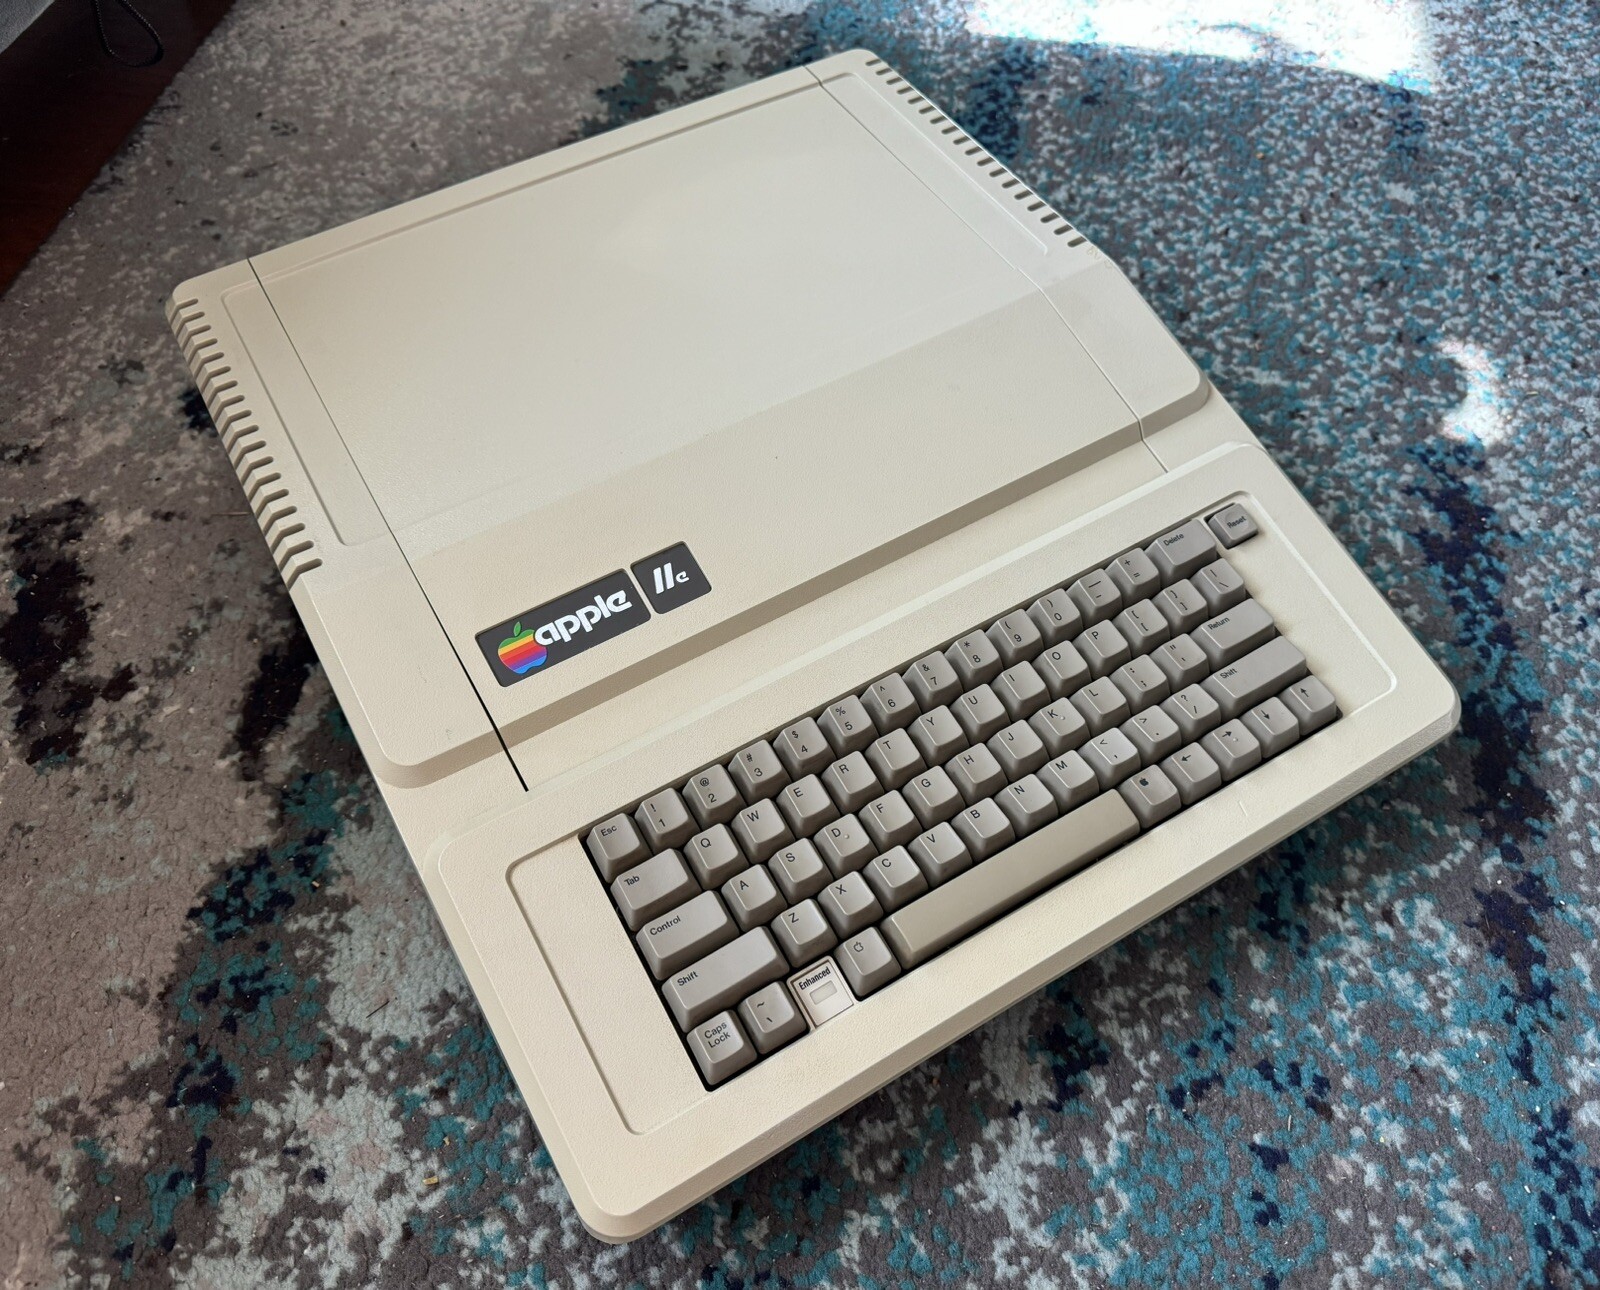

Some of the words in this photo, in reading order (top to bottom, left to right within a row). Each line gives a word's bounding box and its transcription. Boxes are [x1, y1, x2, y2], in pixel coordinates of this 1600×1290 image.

[1227, 516, 1246, 529] Reset
[1163, 533, 1184, 546] Delete
[535, 590, 632, 642] apple
[1208, 617, 1230, 630] Return
[1014, 634, 1022, 642] 9
[1092, 631, 1099, 639] P
[973, 655, 981, 663] 8
[1052, 652, 1061, 660] O
[1220, 668, 1238, 679] Shift
[930, 677, 938, 685] 7
[1088, 689, 1098, 697] L
[888, 699, 895, 708] 6
[968, 696, 978, 705] U
[1048, 709, 1058, 718] K
[845, 722, 852, 730] 5
[926, 717, 935, 726] Y
[1008, 732, 1014, 741] J
[801, 745, 808, 753] 4
[883, 741, 892, 750] T
[964, 755, 974, 764] H
[839, 764, 849, 774] R
[1056, 760, 1068, 770] M
[754, 768, 762, 777] 3
[921, 778, 931, 788] G
[793, 788, 803, 798] E
[1014, 785, 1025, 794] N
[708, 793, 717, 803] 2
[876, 803, 884, 813] F
[747, 810, 759, 822] W
[970, 810, 980, 818] B
[658, 819, 666, 827] 1
[601, 825, 617, 837] Esc
[831, 828, 841, 838] D
[701, 838, 711, 848] Q
[927, 834, 935, 843] V
[786, 853, 795, 862] S
[882, 859, 891, 868] C
[625, 875, 639, 886] Tab
[739, 880, 749, 890] A
[835, 884, 846, 894] X
[788, 912, 799, 923] Z
[650, 916, 681, 935] Control
[677, 971, 698, 987] Shift
[799, 966, 831, 990] Enhanced
[704, 1022, 727, 1040] Caps
[708, 1031, 730, 1048] Lock
